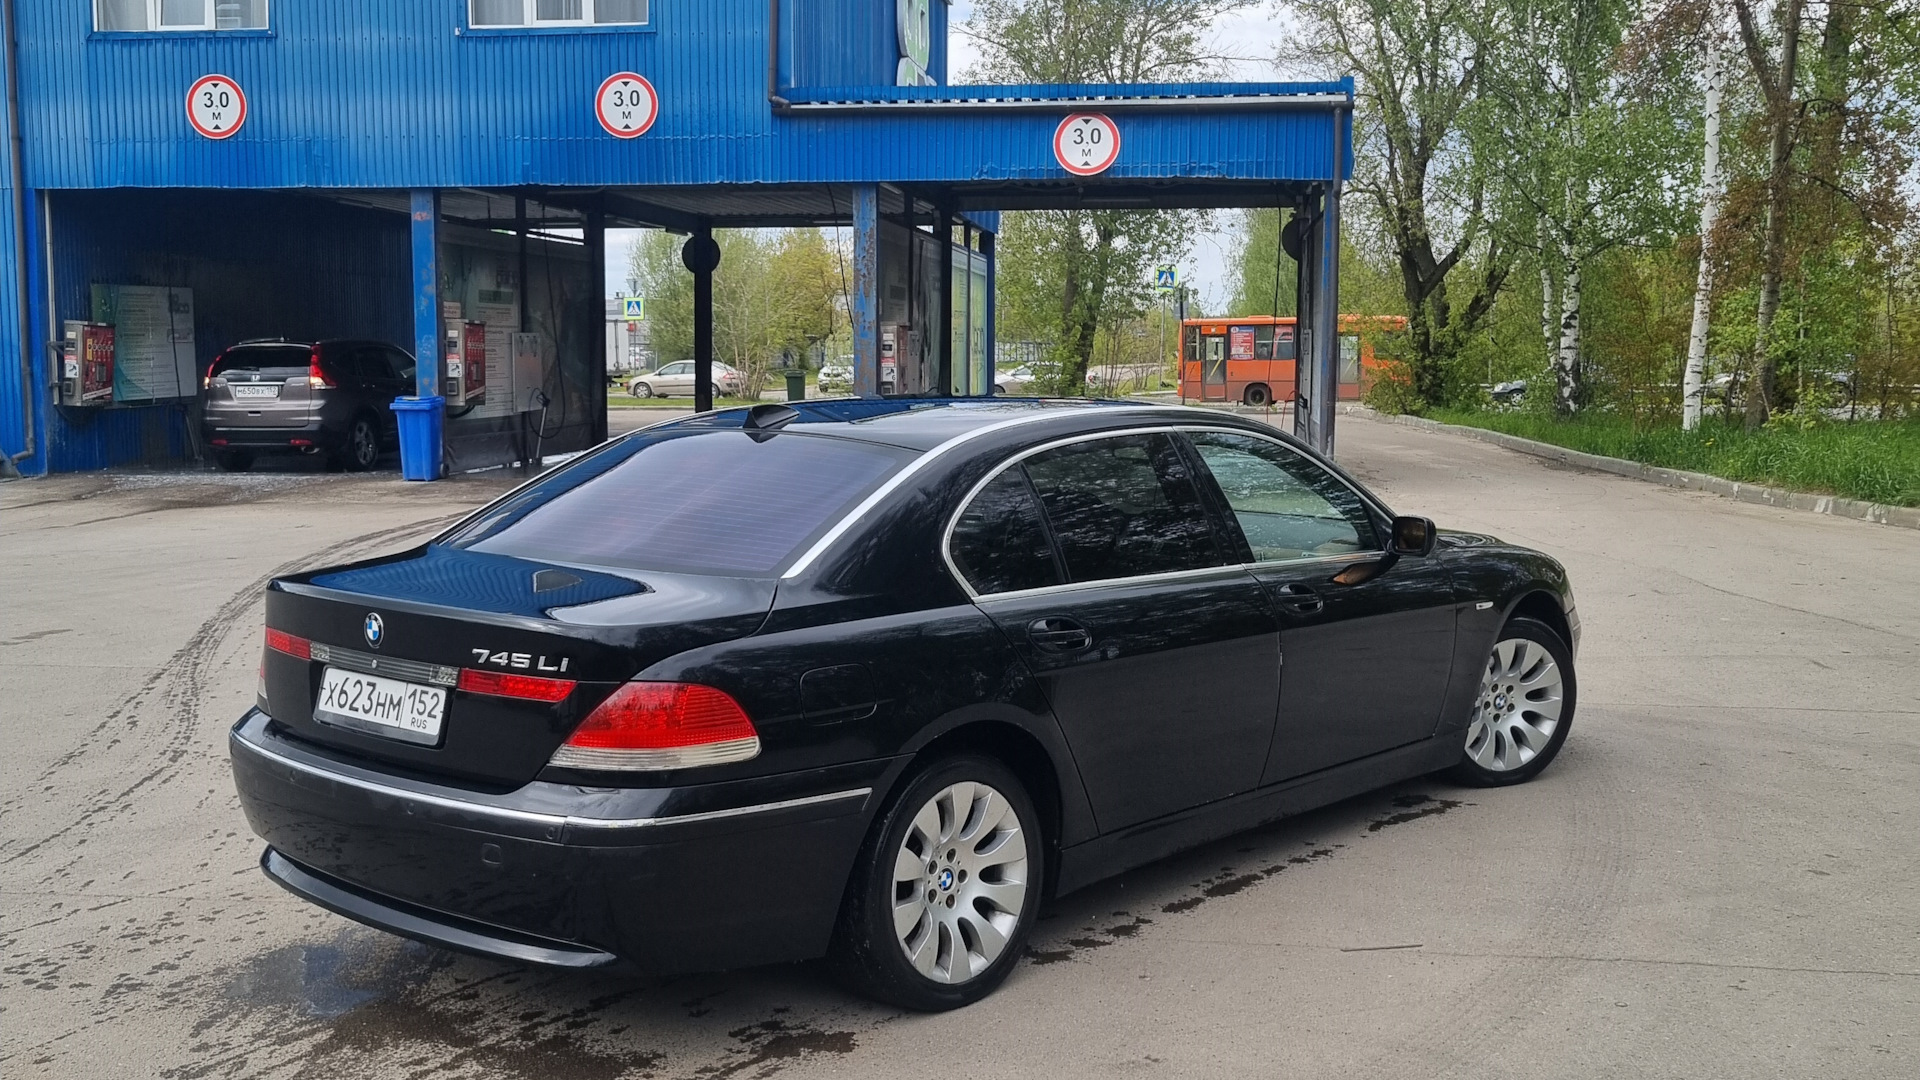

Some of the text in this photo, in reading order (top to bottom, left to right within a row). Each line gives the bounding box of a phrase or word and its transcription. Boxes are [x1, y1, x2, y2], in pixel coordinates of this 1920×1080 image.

[203, 91, 229, 110] 3,0
[613, 90, 640, 109] 3,0
[1073, 127, 1101, 147] 3,0
[472, 648, 532, 668] 745
[408, 688, 440, 719] 152
[410, 717, 428, 729] RUS
